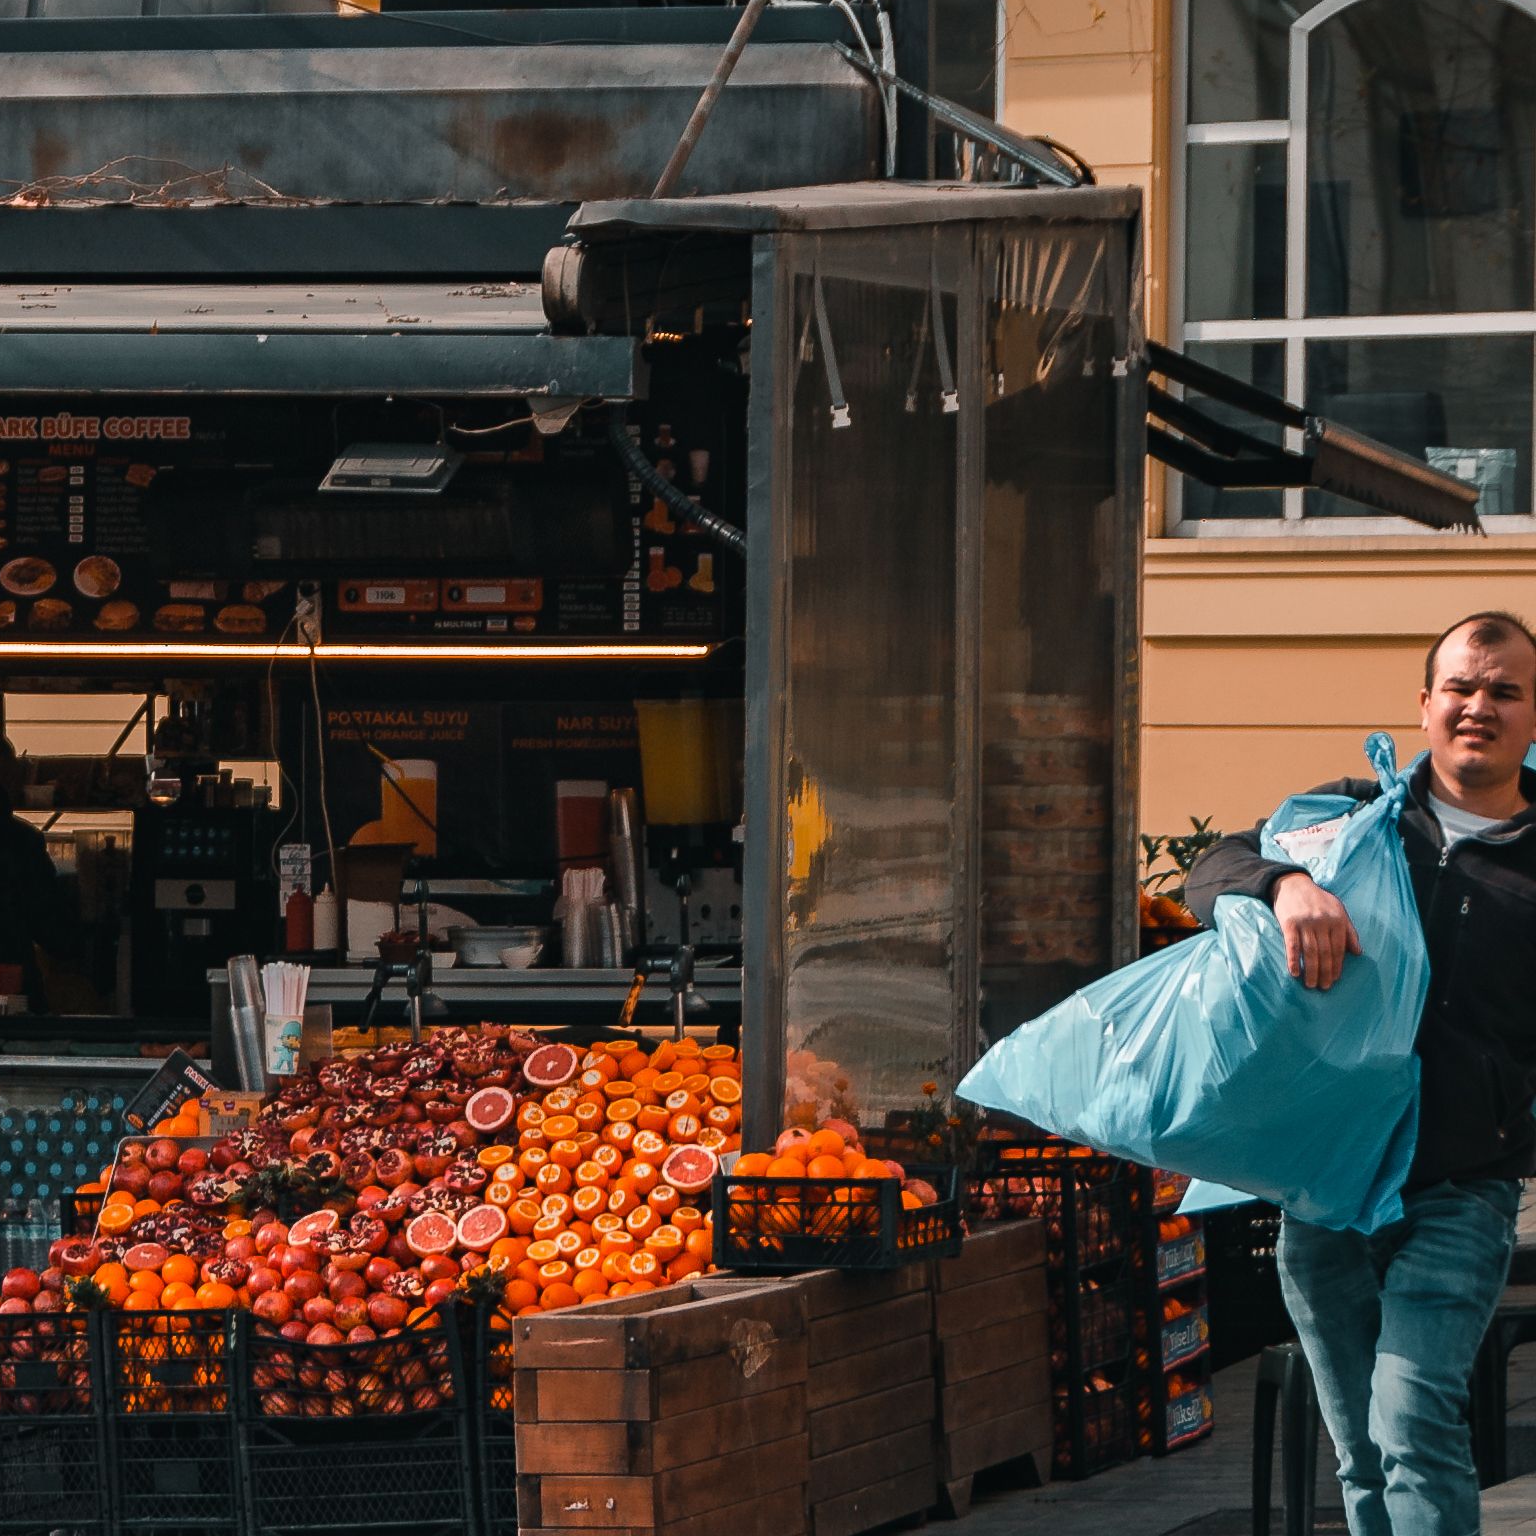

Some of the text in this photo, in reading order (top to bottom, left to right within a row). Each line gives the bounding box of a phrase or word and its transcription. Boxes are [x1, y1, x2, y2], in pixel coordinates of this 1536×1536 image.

[40, 411, 101, 440] BÜFE
[104, 416, 192, 440] COFFEE
[48, 444, 97, 457] MENU
[443, 620, 483, 630] MULTINET
[327, 710, 470, 726] PORTAKAL SUYU
[556, 715, 594, 731] NAR
[374, 729, 428, 741] ORANGE
[430, 729, 465, 741] JUICE
[512, 737, 553, 750] FRESH
